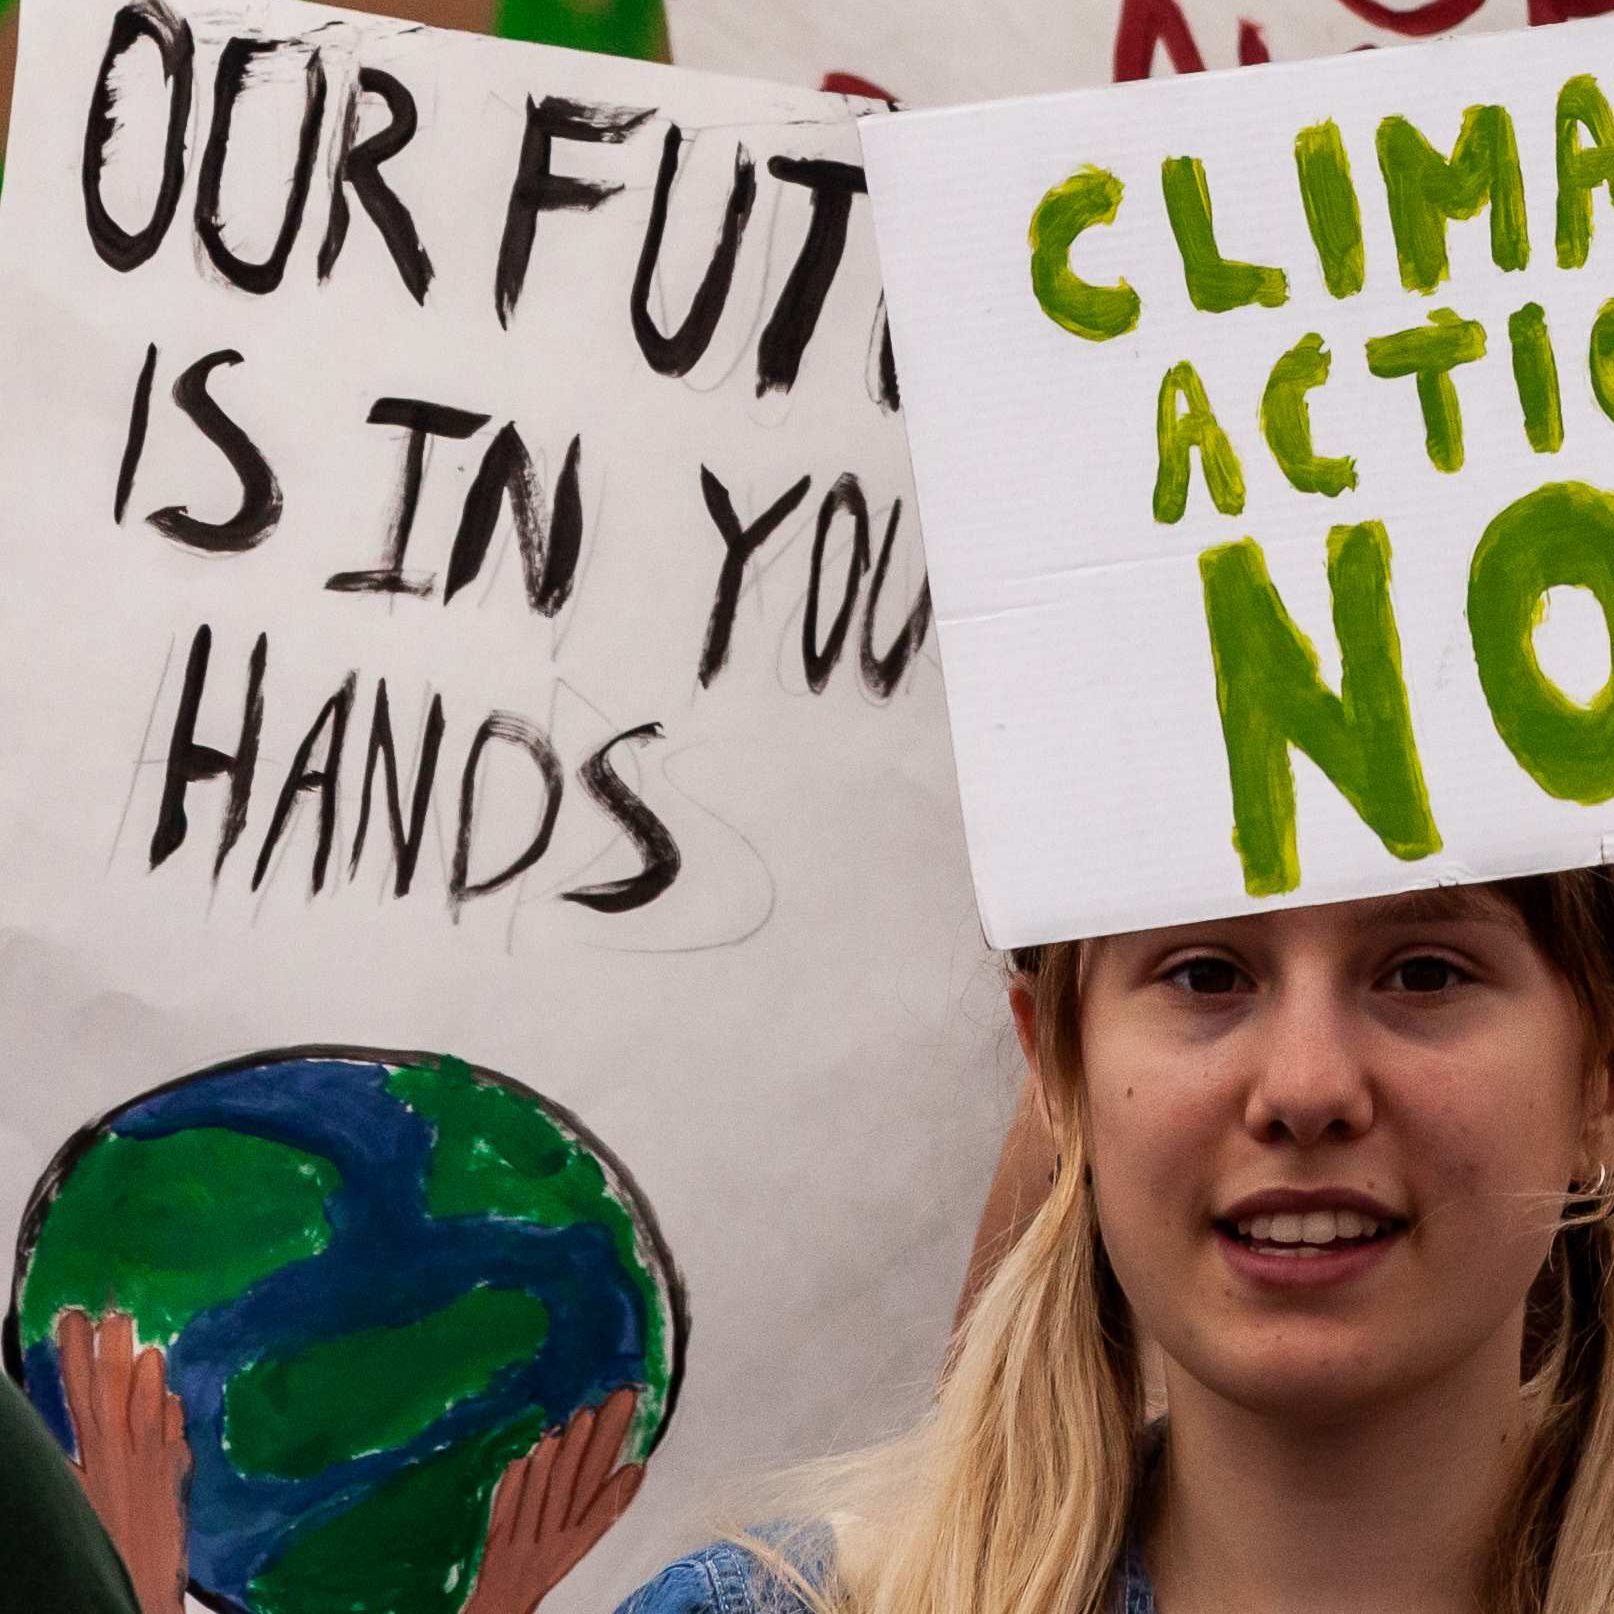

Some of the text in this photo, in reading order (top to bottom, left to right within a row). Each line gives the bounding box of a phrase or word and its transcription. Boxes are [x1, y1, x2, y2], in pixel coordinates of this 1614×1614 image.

[494, 92, 901, 413] FUT
[114, 341, 284, 554] IS
[323, 396, 586, 620] IN
[148, 622, 683, 924] HANDS
